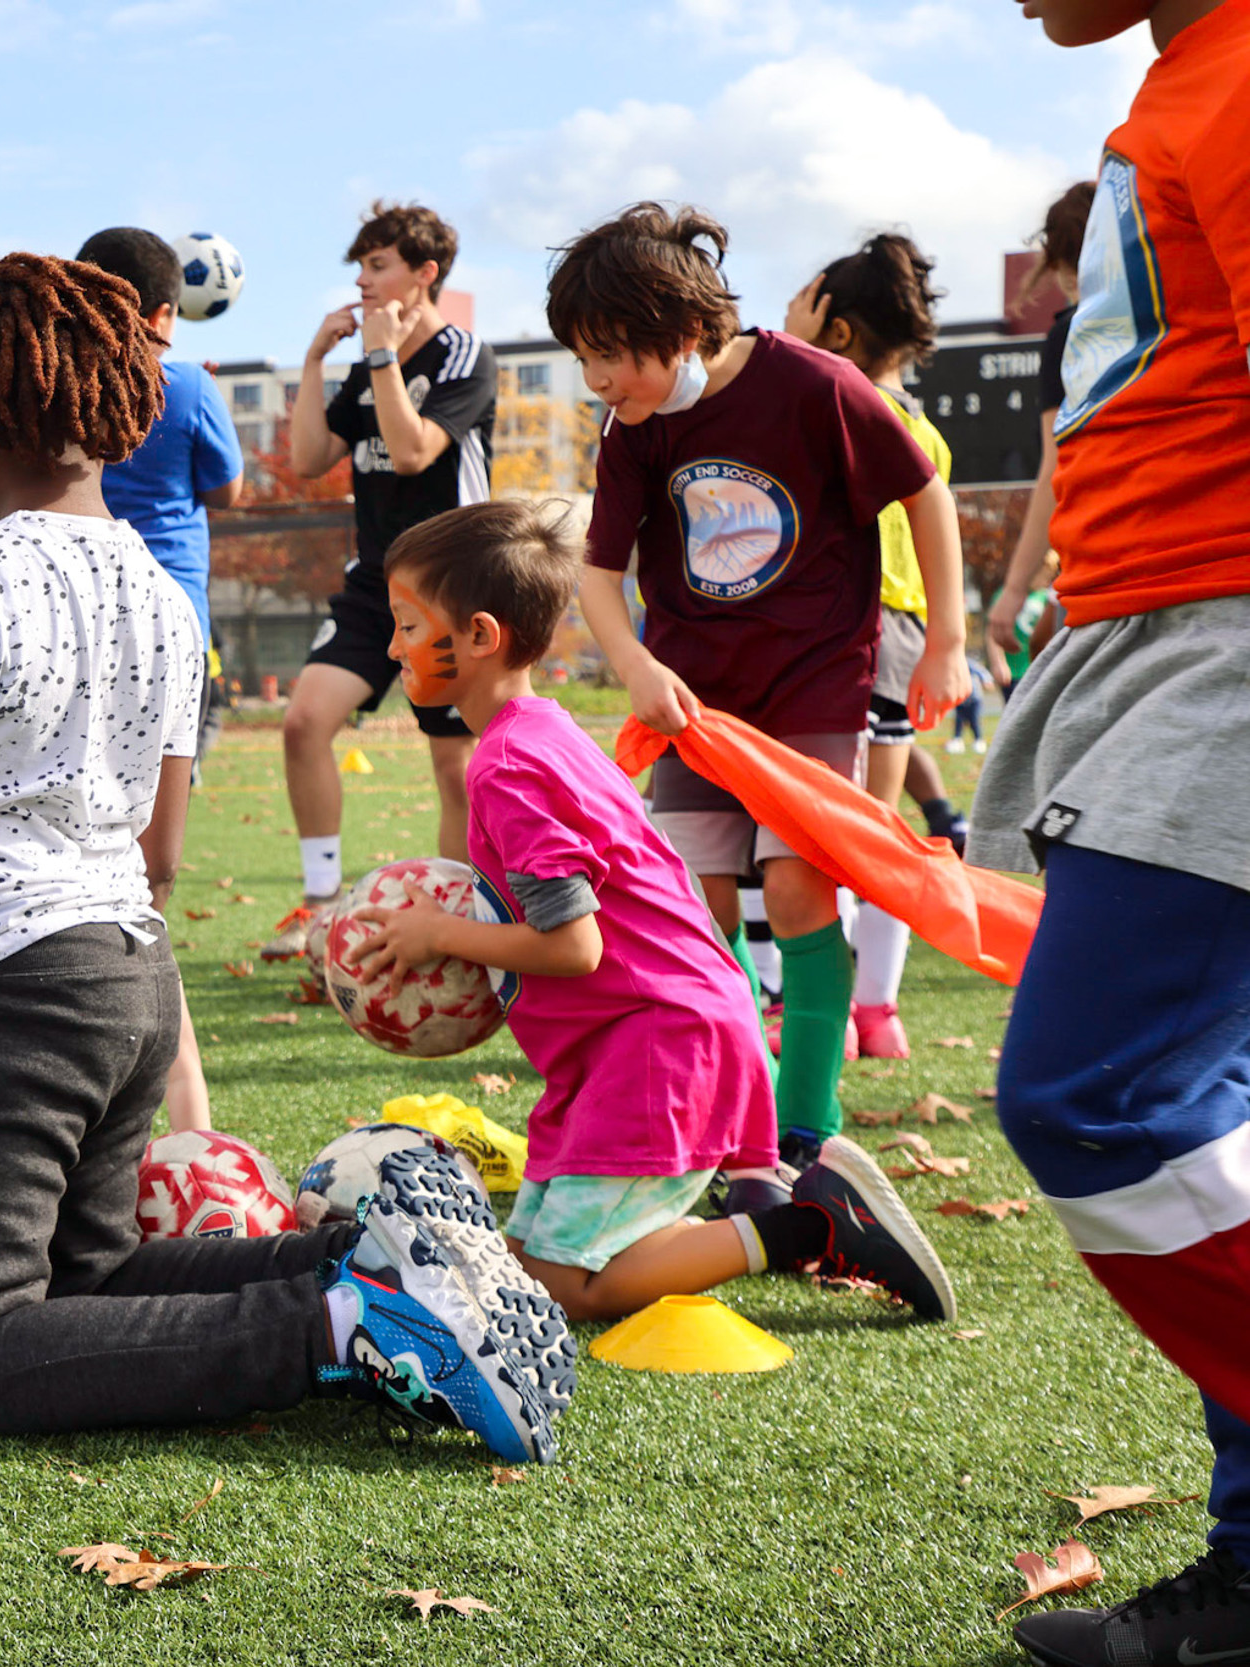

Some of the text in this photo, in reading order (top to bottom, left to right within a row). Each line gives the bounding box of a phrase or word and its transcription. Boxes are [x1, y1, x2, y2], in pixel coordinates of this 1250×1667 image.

[937, 389, 1023, 417] 2 3 4
[695, 465, 719, 479] END
[721, 466, 773, 492] SOCCER
[700, 577, 758, 596] EST. 2008
